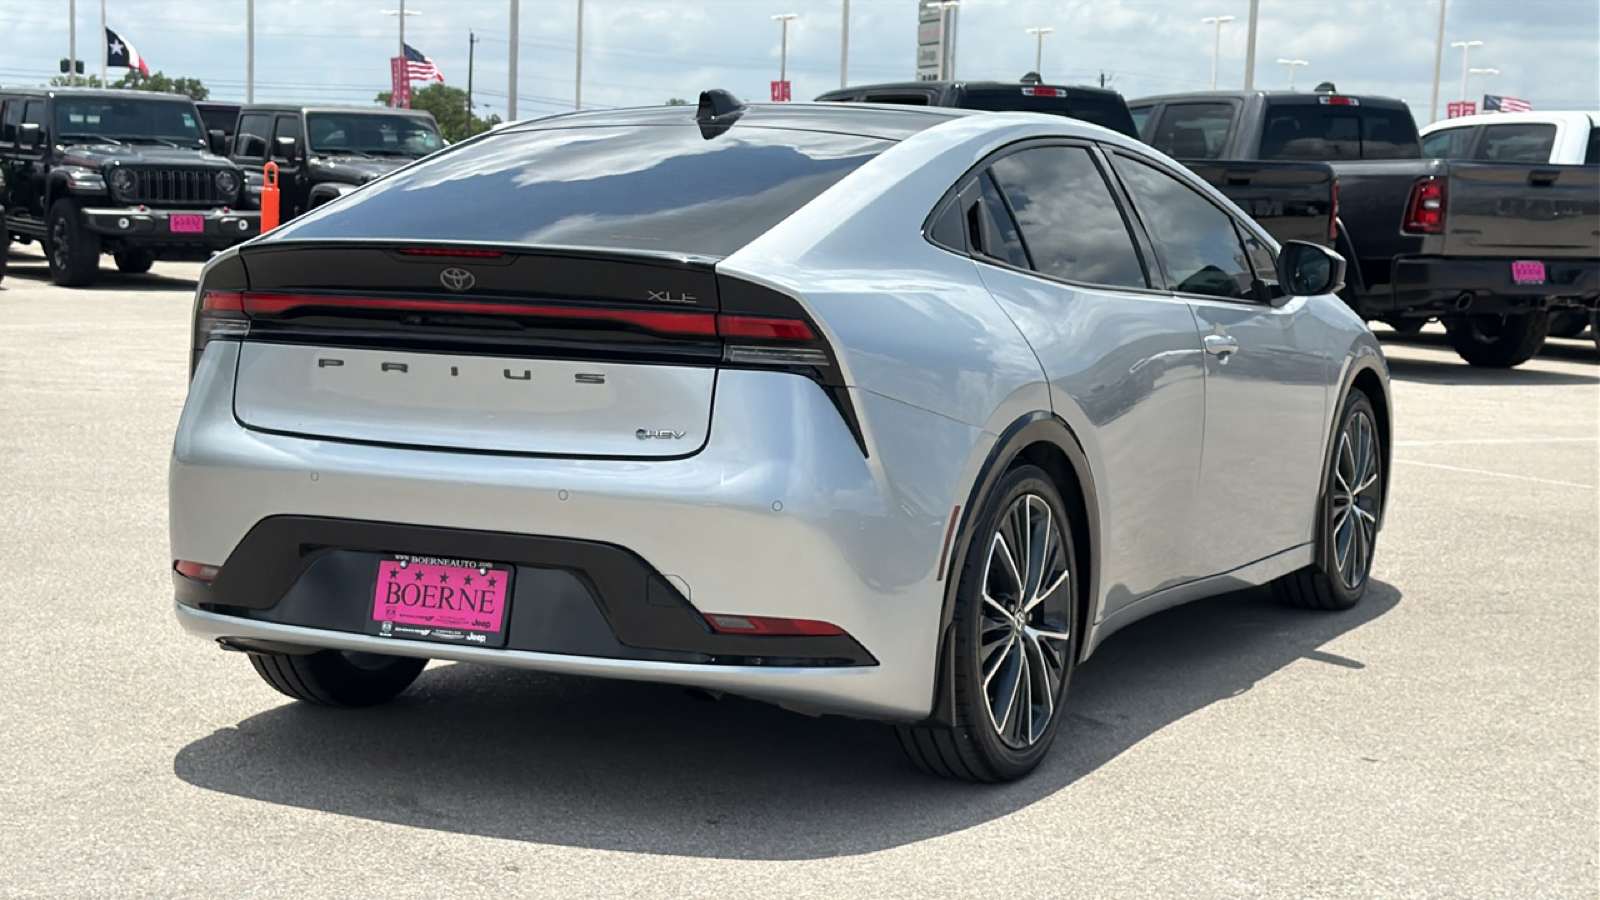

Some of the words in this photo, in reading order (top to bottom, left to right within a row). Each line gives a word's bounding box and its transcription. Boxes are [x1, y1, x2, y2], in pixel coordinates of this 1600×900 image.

[648, 290, 697, 303] XLE
[318, 358, 606, 385] PRIUS
[411, 556, 477, 569] BOERNEAUTO
[385, 582, 496, 614] BOERNE
[471, 618, 491, 629] Jeep
[466, 631, 487, 644] Jeep
